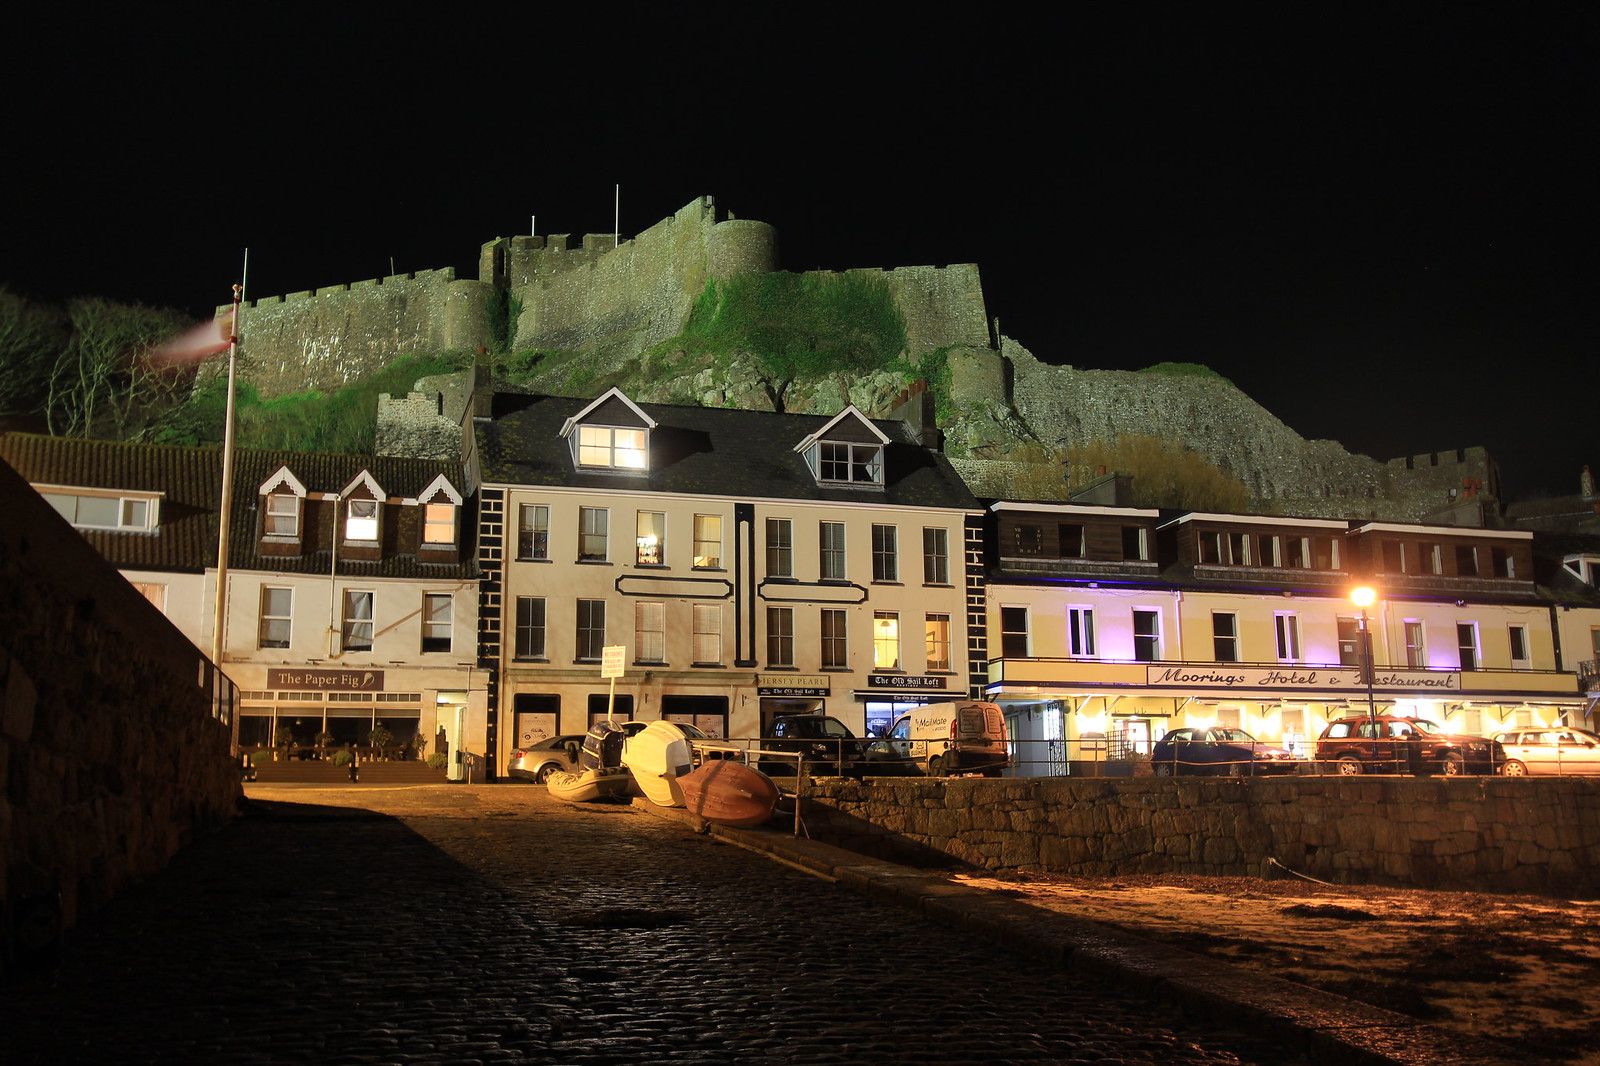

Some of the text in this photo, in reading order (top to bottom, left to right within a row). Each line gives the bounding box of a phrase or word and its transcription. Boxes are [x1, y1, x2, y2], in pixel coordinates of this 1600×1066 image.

[278, 672, 359, 688] The Paper Fig
[762, 677, 825, 686] JERSEY PEARL
[875, 676, 939, 686] The Old Sail Loft
[1155, 669, 1244, 686] Moorings
[1258, 671, 1317, 687] Hotel
[1329, 676, 1341, 685] &
